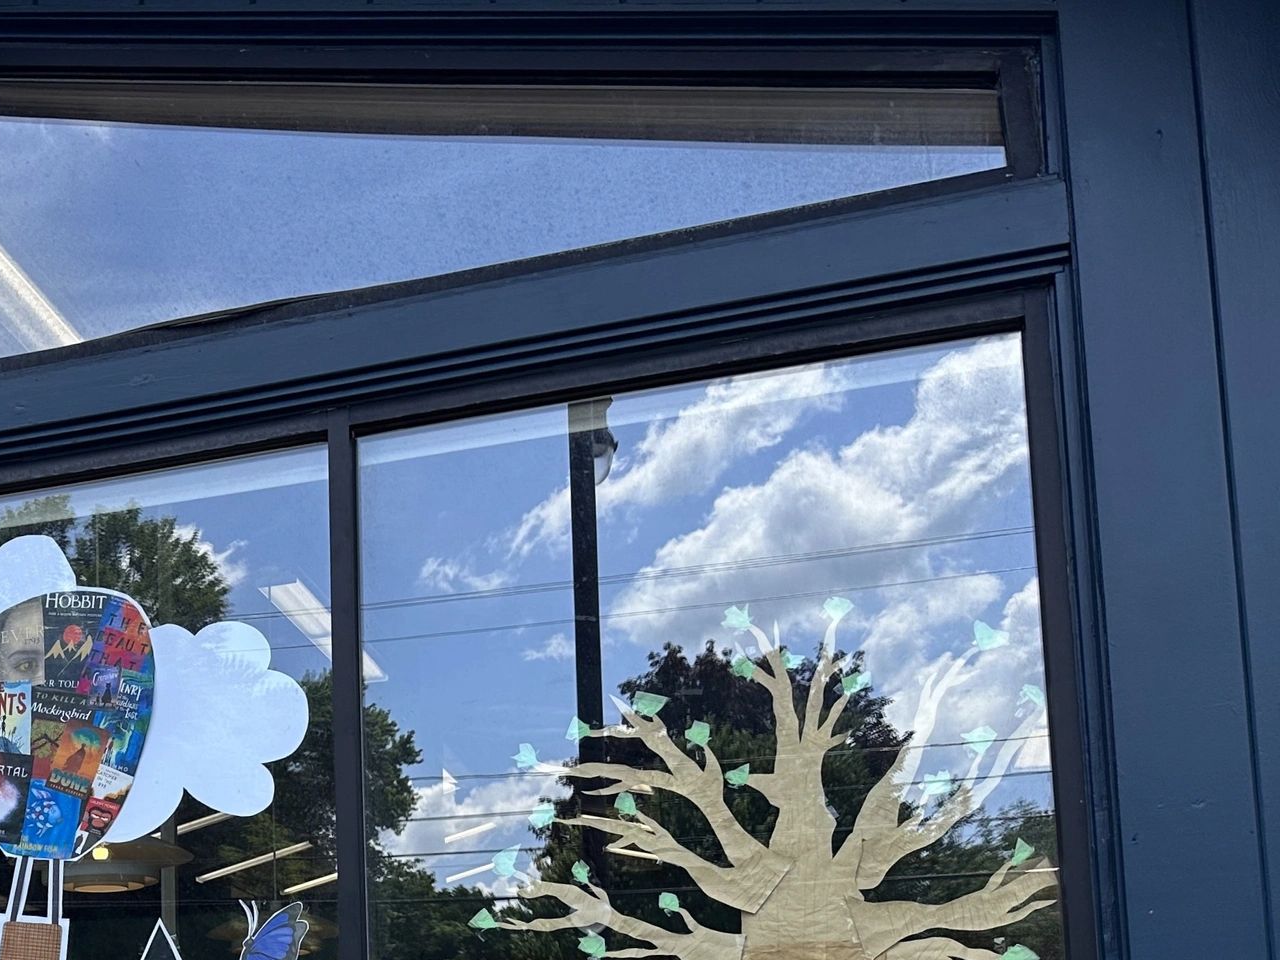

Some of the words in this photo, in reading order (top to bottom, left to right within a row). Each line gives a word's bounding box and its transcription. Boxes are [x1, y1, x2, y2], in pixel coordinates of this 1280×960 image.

[45, 593, 107, 609] HOBBIT
[51, 694, 76, 704] KILL
[30, 702, 93, 722] Mockingbird
[49, 767, 90, 794] DUNE
